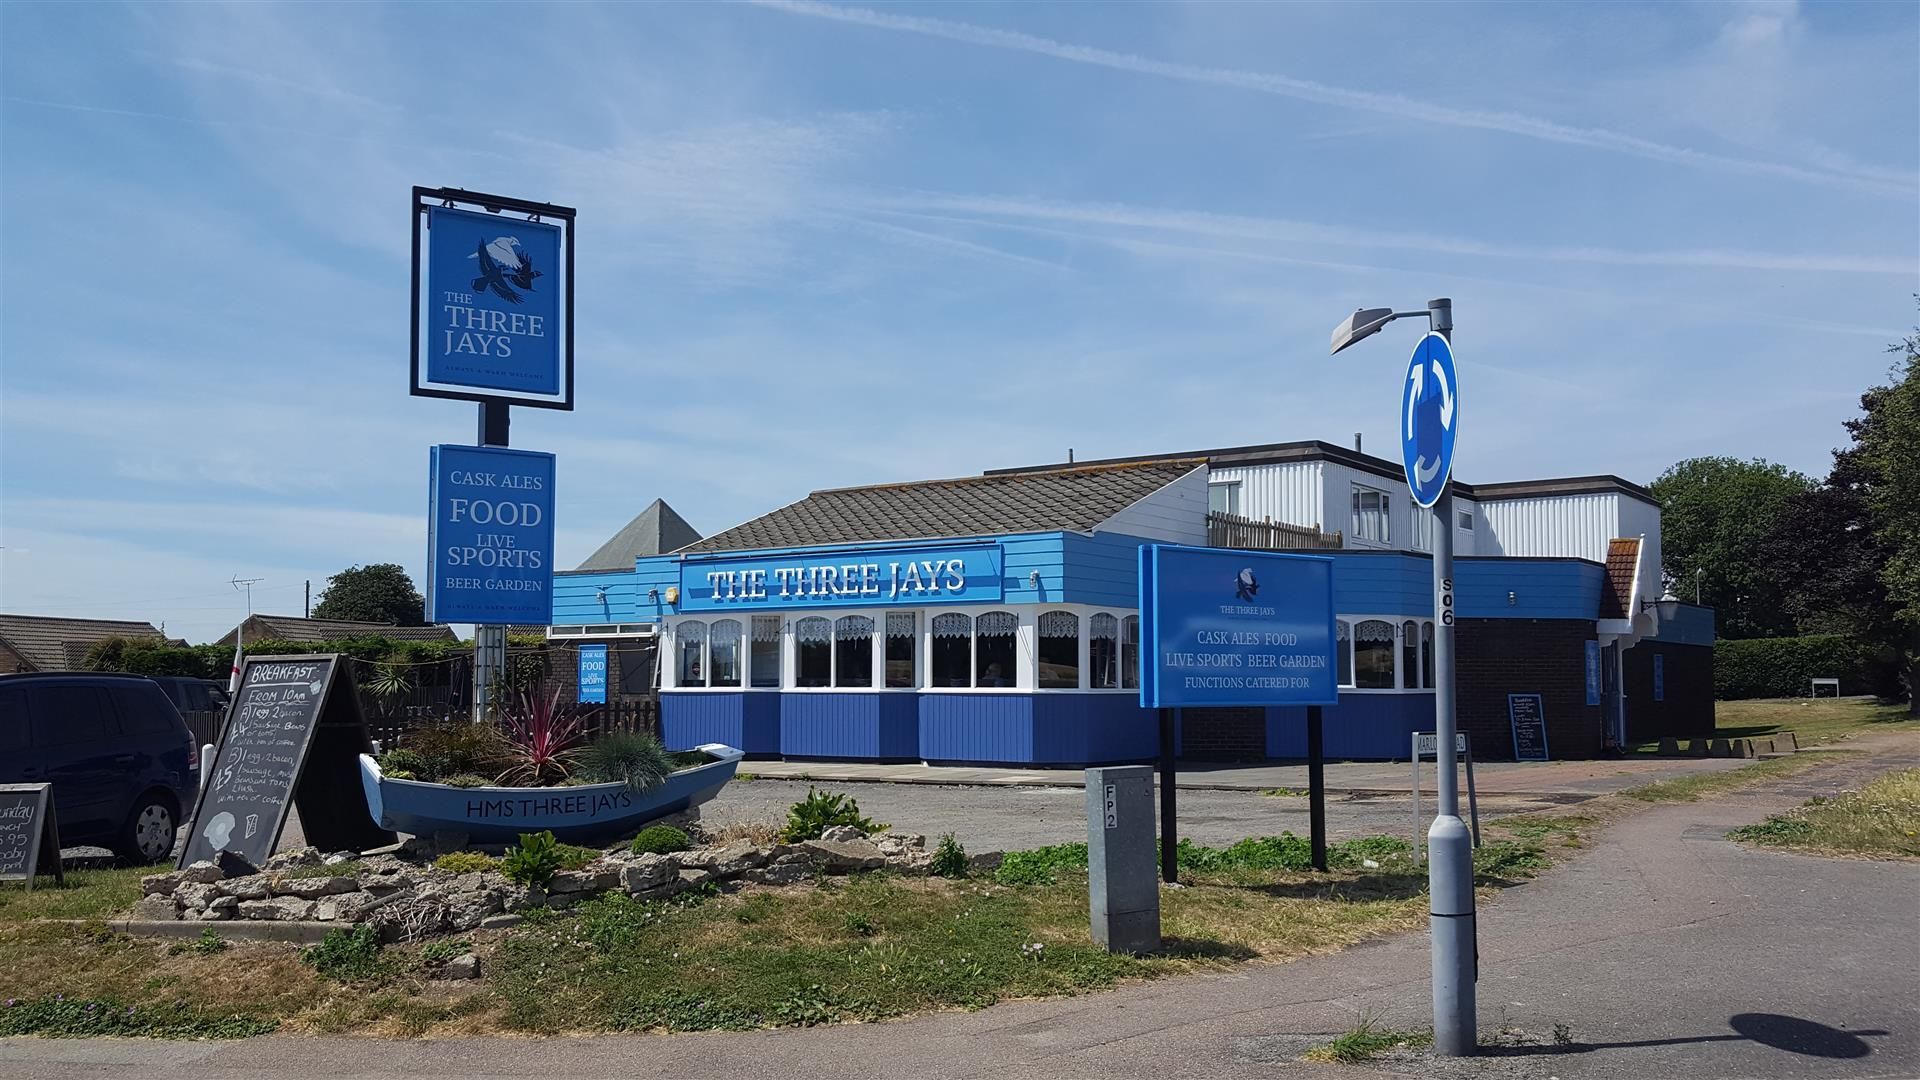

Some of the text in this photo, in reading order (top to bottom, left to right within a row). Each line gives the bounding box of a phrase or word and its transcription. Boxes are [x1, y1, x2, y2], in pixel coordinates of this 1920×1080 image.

[444, 291, 473, 304] THE
[444, 305, 544, 337] THREE
[444, 330, 512, 357] JAYS
[451, 471, 542, 490] CASK ALES
[449, 498, 542, 527] FOOD
[476, 534, 515, 548] LIVE
[447, 546, 541, 569] SPORTS
[446, 577, 542, 591] BEER GARDEN
[707, 559, 965, 599] THE THREE JAYS
[1220, 605, 1276, 616] THE THREE JAYS
[1197, 631, 1297, 646] CASK ALES FOOD
[582, 661, 605, 671] FOOD
[1166, 653, 1326, 668] LIVE SPORTS BEER GARDEN
[251, 664, 317, 683] BREAKFAST
[1185, 677, 1310, 688] FUNCTIONS CATERED FOR
[248, 689, 277, 702] FROM
[467, 791, 632, 817] HMS THREE JAYS
[1106, 785, 1116, 827] FP2
